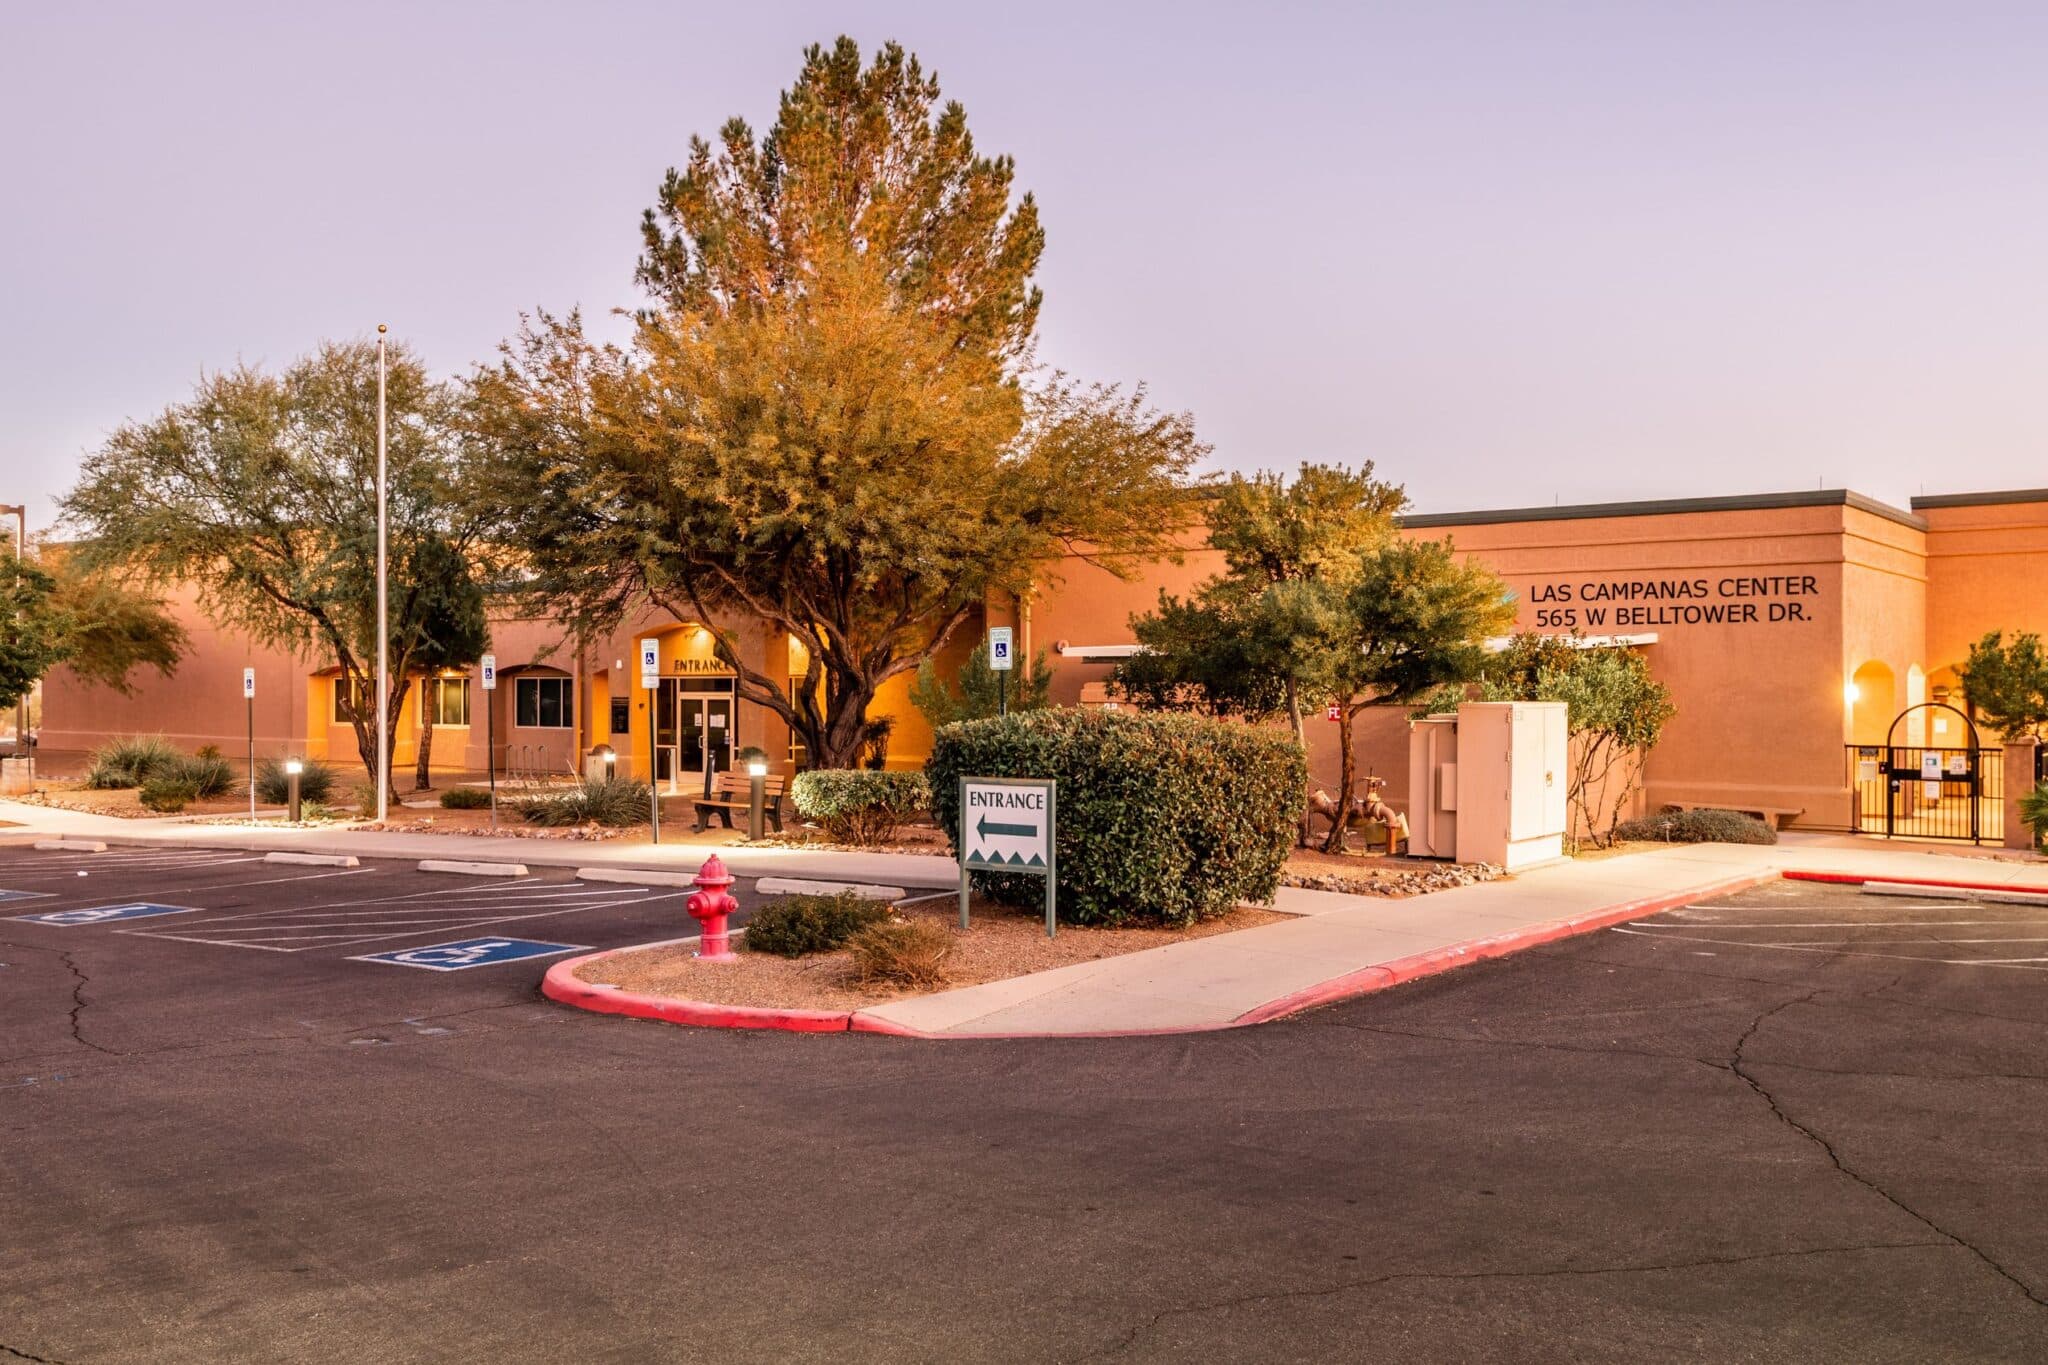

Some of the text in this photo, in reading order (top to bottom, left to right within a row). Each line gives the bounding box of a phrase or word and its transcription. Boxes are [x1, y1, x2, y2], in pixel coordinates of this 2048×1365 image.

[1531, 575, 1819, 602] LAS CAMPANAS CENTER
[1536, 602, 1812, 627] 565 W BELLTOWER DR.
[970, 791, 1043, 810] ENTRANCE
